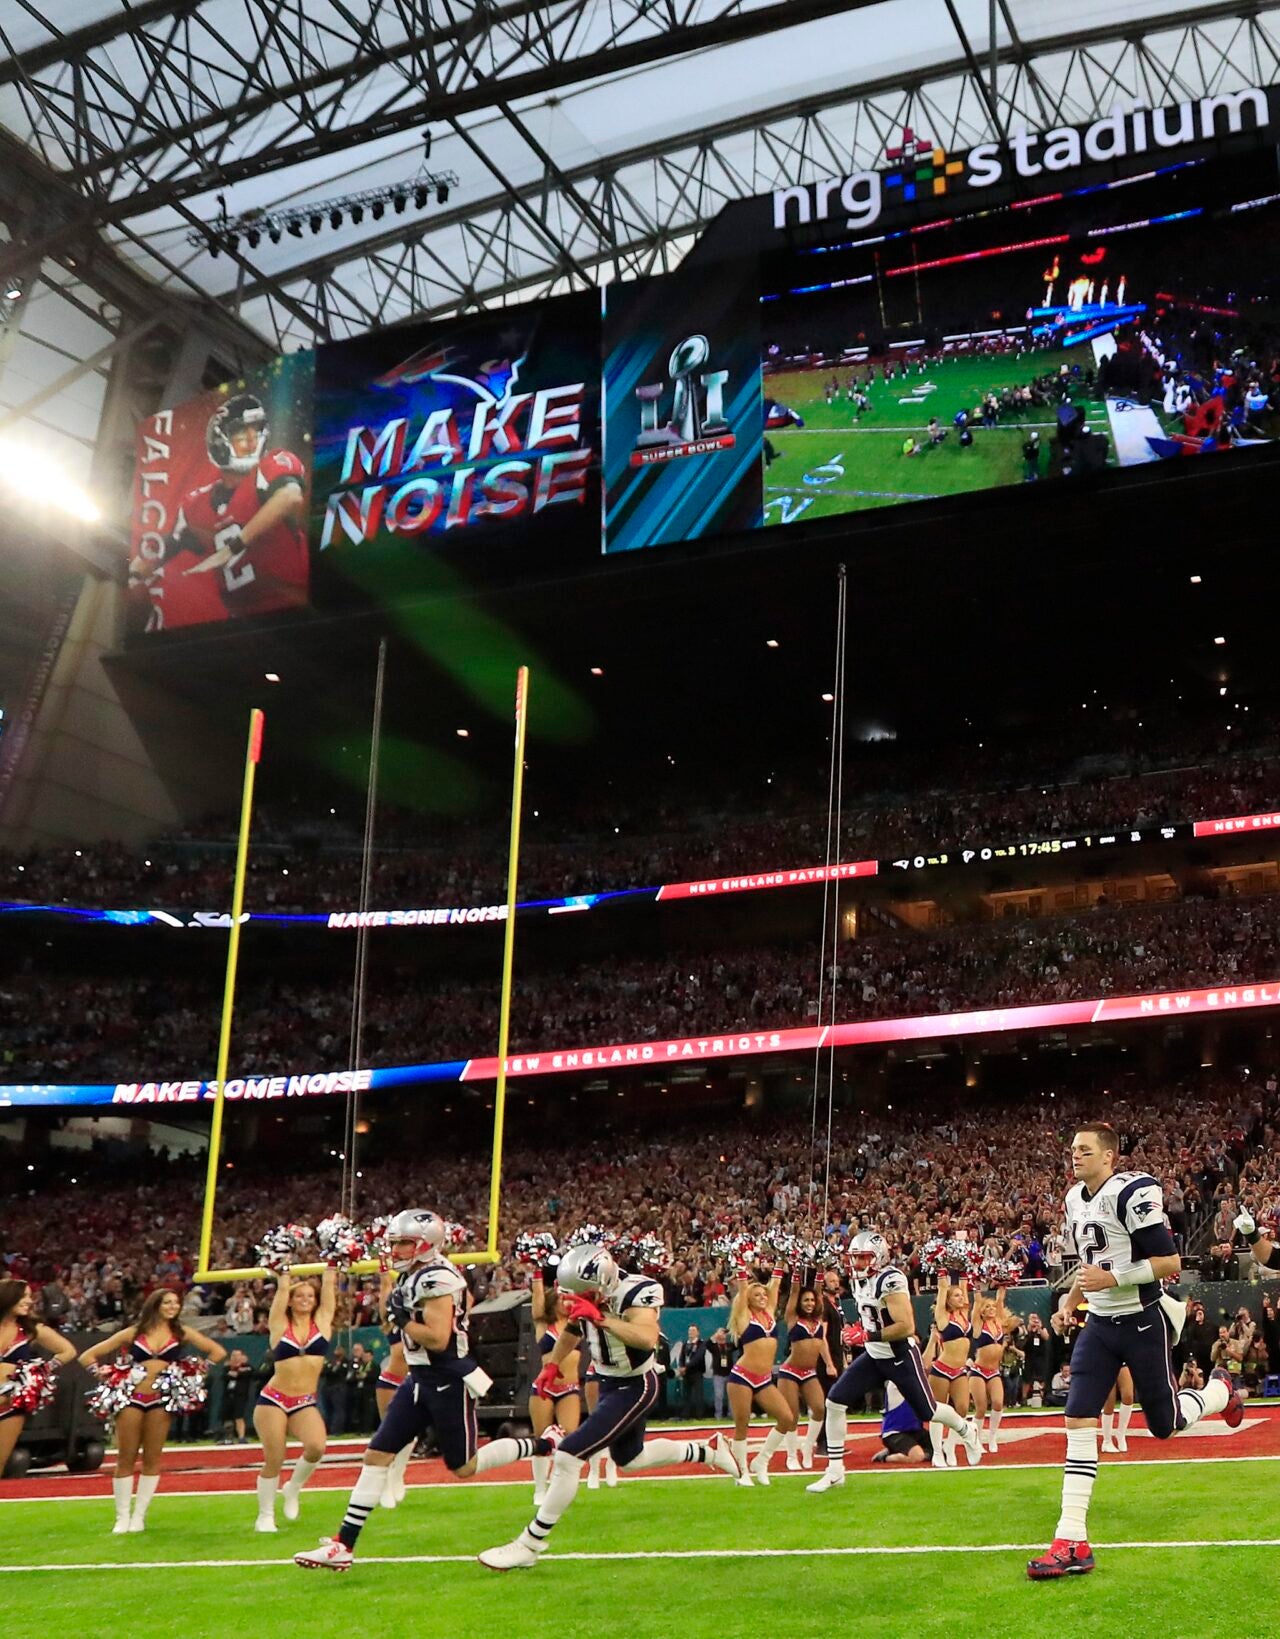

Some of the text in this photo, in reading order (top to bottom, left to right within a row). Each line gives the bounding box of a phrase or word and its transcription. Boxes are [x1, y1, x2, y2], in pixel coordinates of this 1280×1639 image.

[773, 86, 1270, 230] nrg stadium
[338, 381, 586, 485] MAKE
[641, 440, 723, 463] SUPER BOWL
[319, 447, 592, 551] NOISE
[1214, 819, 1246, 832] NEW
[1019, 840, 1062, 857] 17:45
[689, 864, 857, 895] NEW ENGLAND PATRIOTS
[327, 904, 510, 928] MAKE SOME NOISE
[1140, 995, 1190, 1012] NEW
[552, 1046, 654, 1067] ENGLAND
[666, 1034, 781, 1056] PATRIOTS
[112, 1069, 372, 1104] MAKE SOME NOISE
[1071, 1221, 1112, 1271] 12
